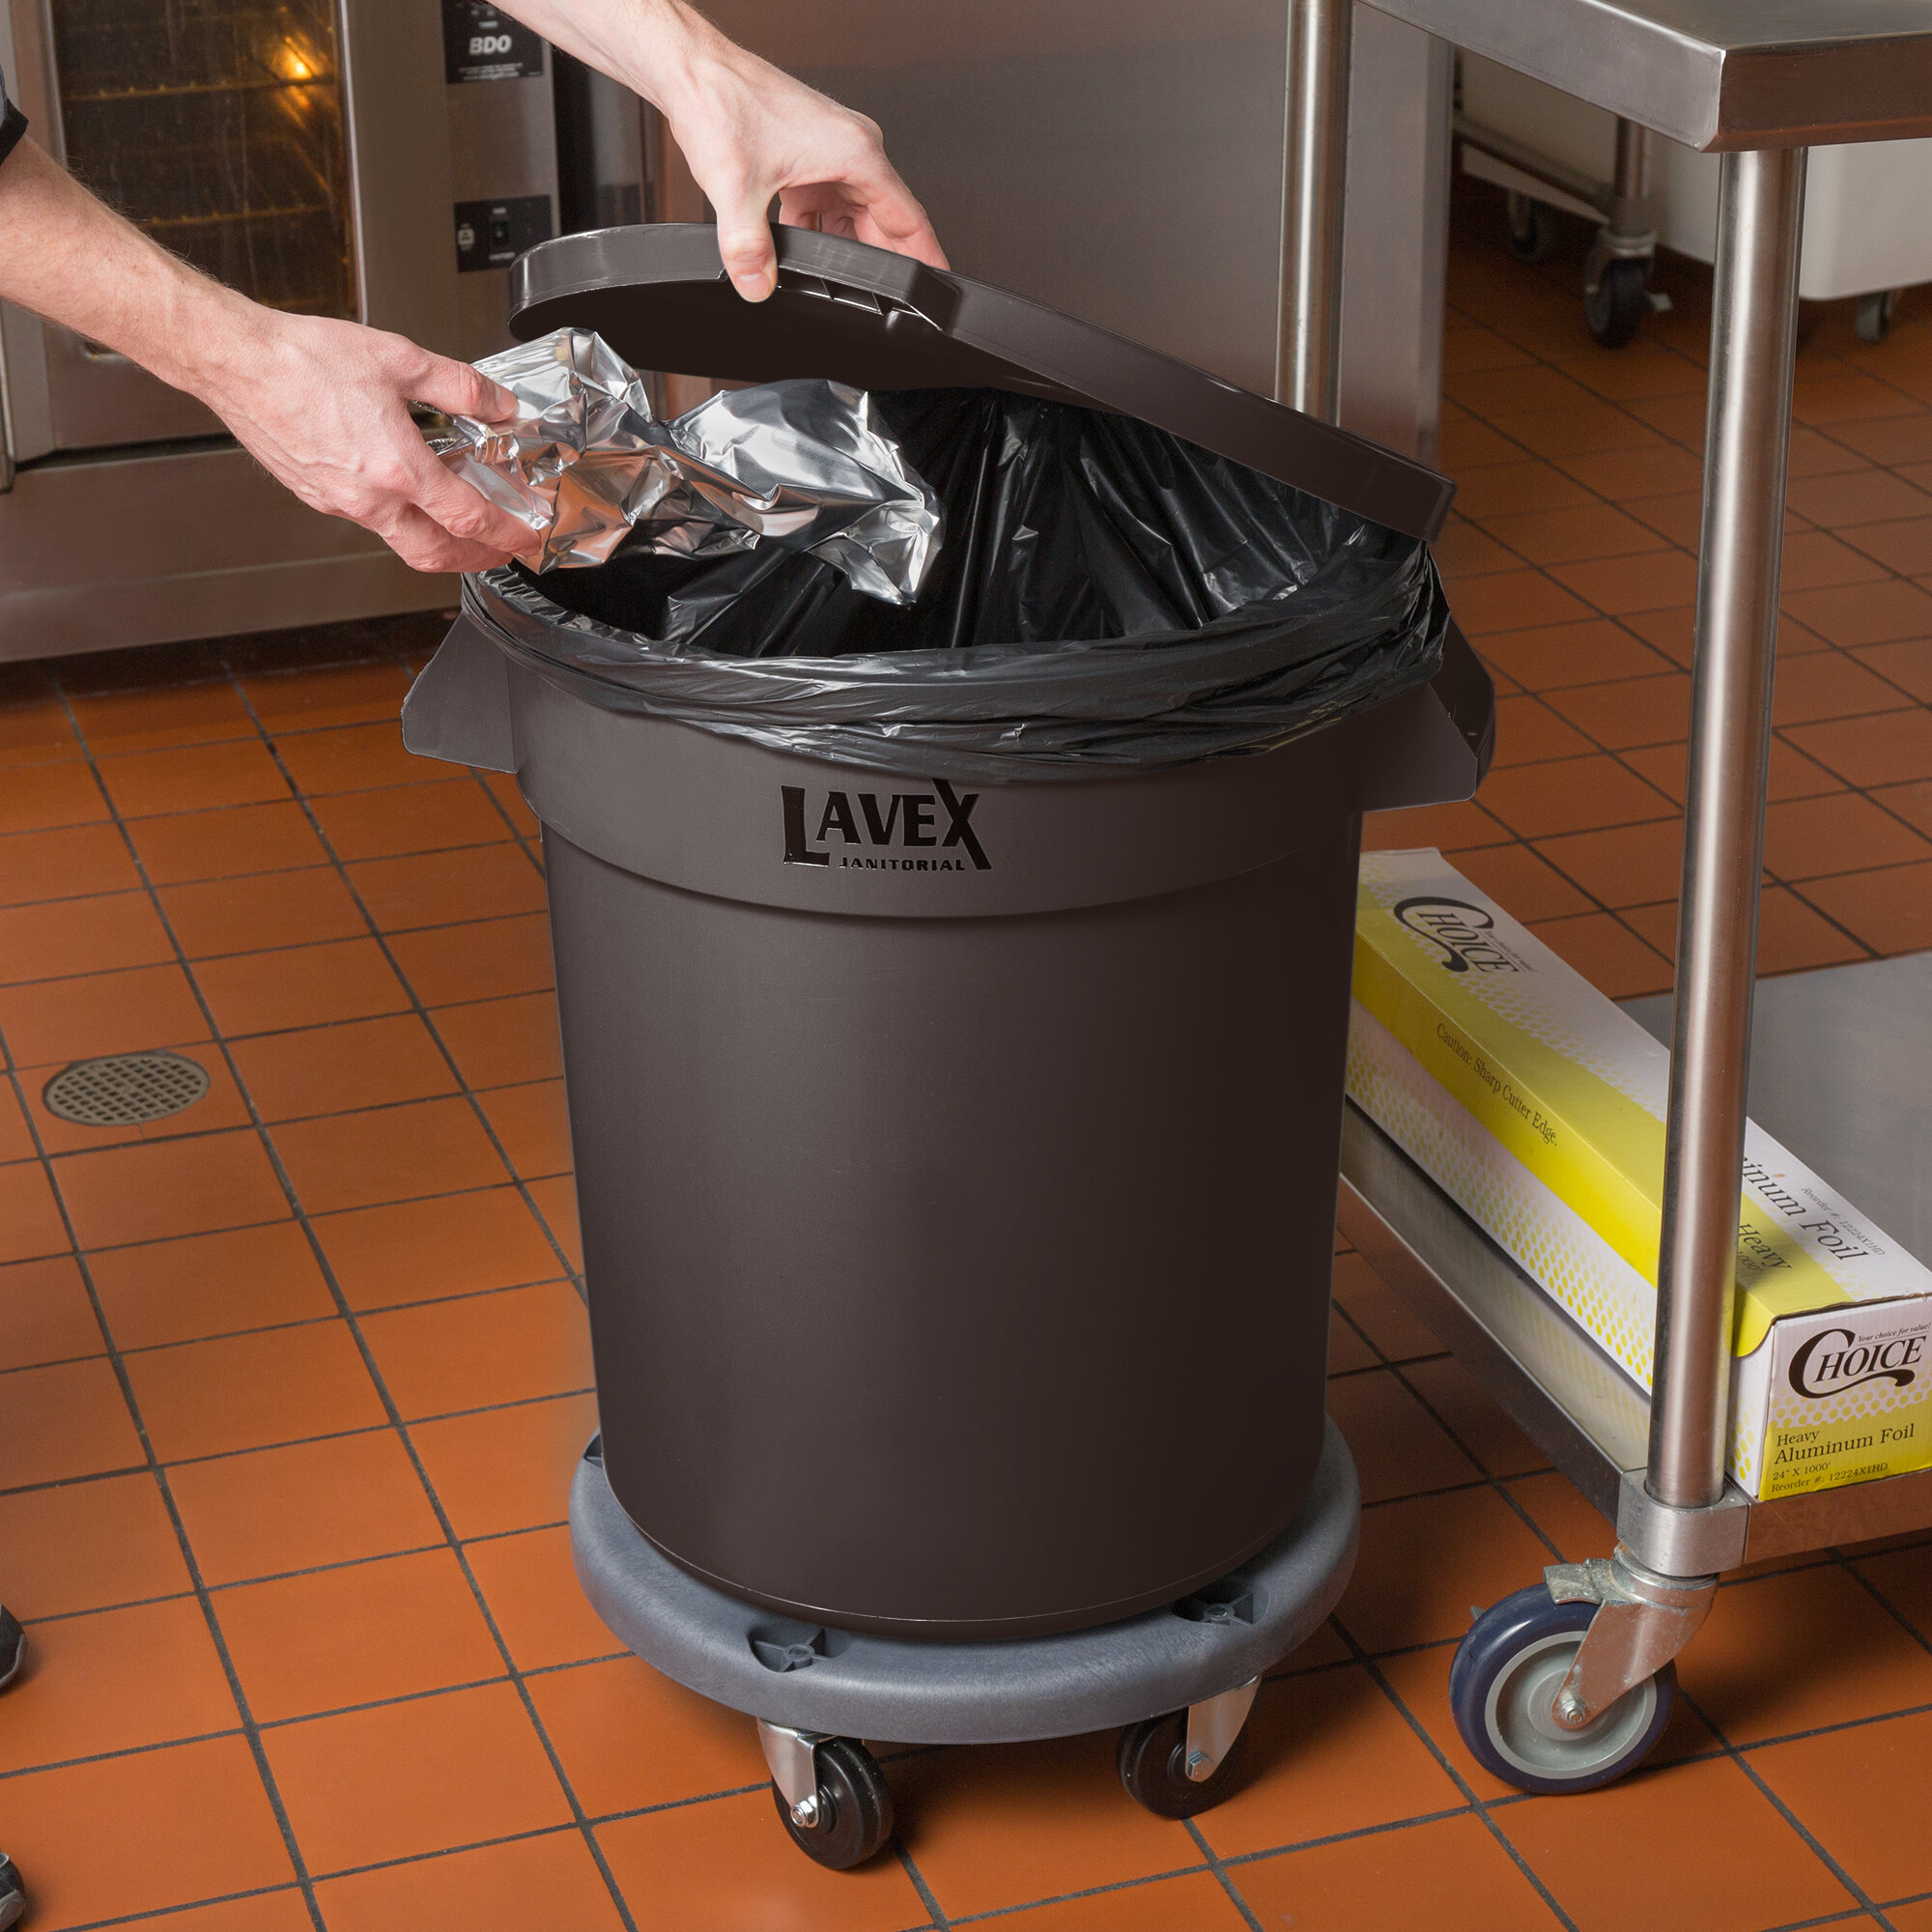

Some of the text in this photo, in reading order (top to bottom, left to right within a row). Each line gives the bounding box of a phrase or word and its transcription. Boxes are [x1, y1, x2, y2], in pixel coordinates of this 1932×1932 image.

[469, 35, 512, 55] BDO
[781, 778, 992, 870] LAVEX
[838, 857, 966, 871] JANITORIAL
[1393, 895, 1520, 974] CHOICE
[1436, 1023, 1558, 1147] Caution: Sharp Cutter Edge.
[1739, 1223, 1793, 1268] Heavy
[1798, 1219, 1869, 1261] Foil
[1858, 1334, 1874, 1344] Your
[1874, 1329, 1898, 1340] choice
[1896, 1326, 1910, 1337] for
[1788, 1328, 1927, 1399] CHOICE
[1774, 1422, 1915, 1465] Aluminum Foil
[1776, 1430, 1820, 1447] Heavy
[1771, 1478, 1811, 1493] Reorder
[1829, 1462, 1889, 1482] 12224X1HD
[1792, 1464, 1803, 1477] X
